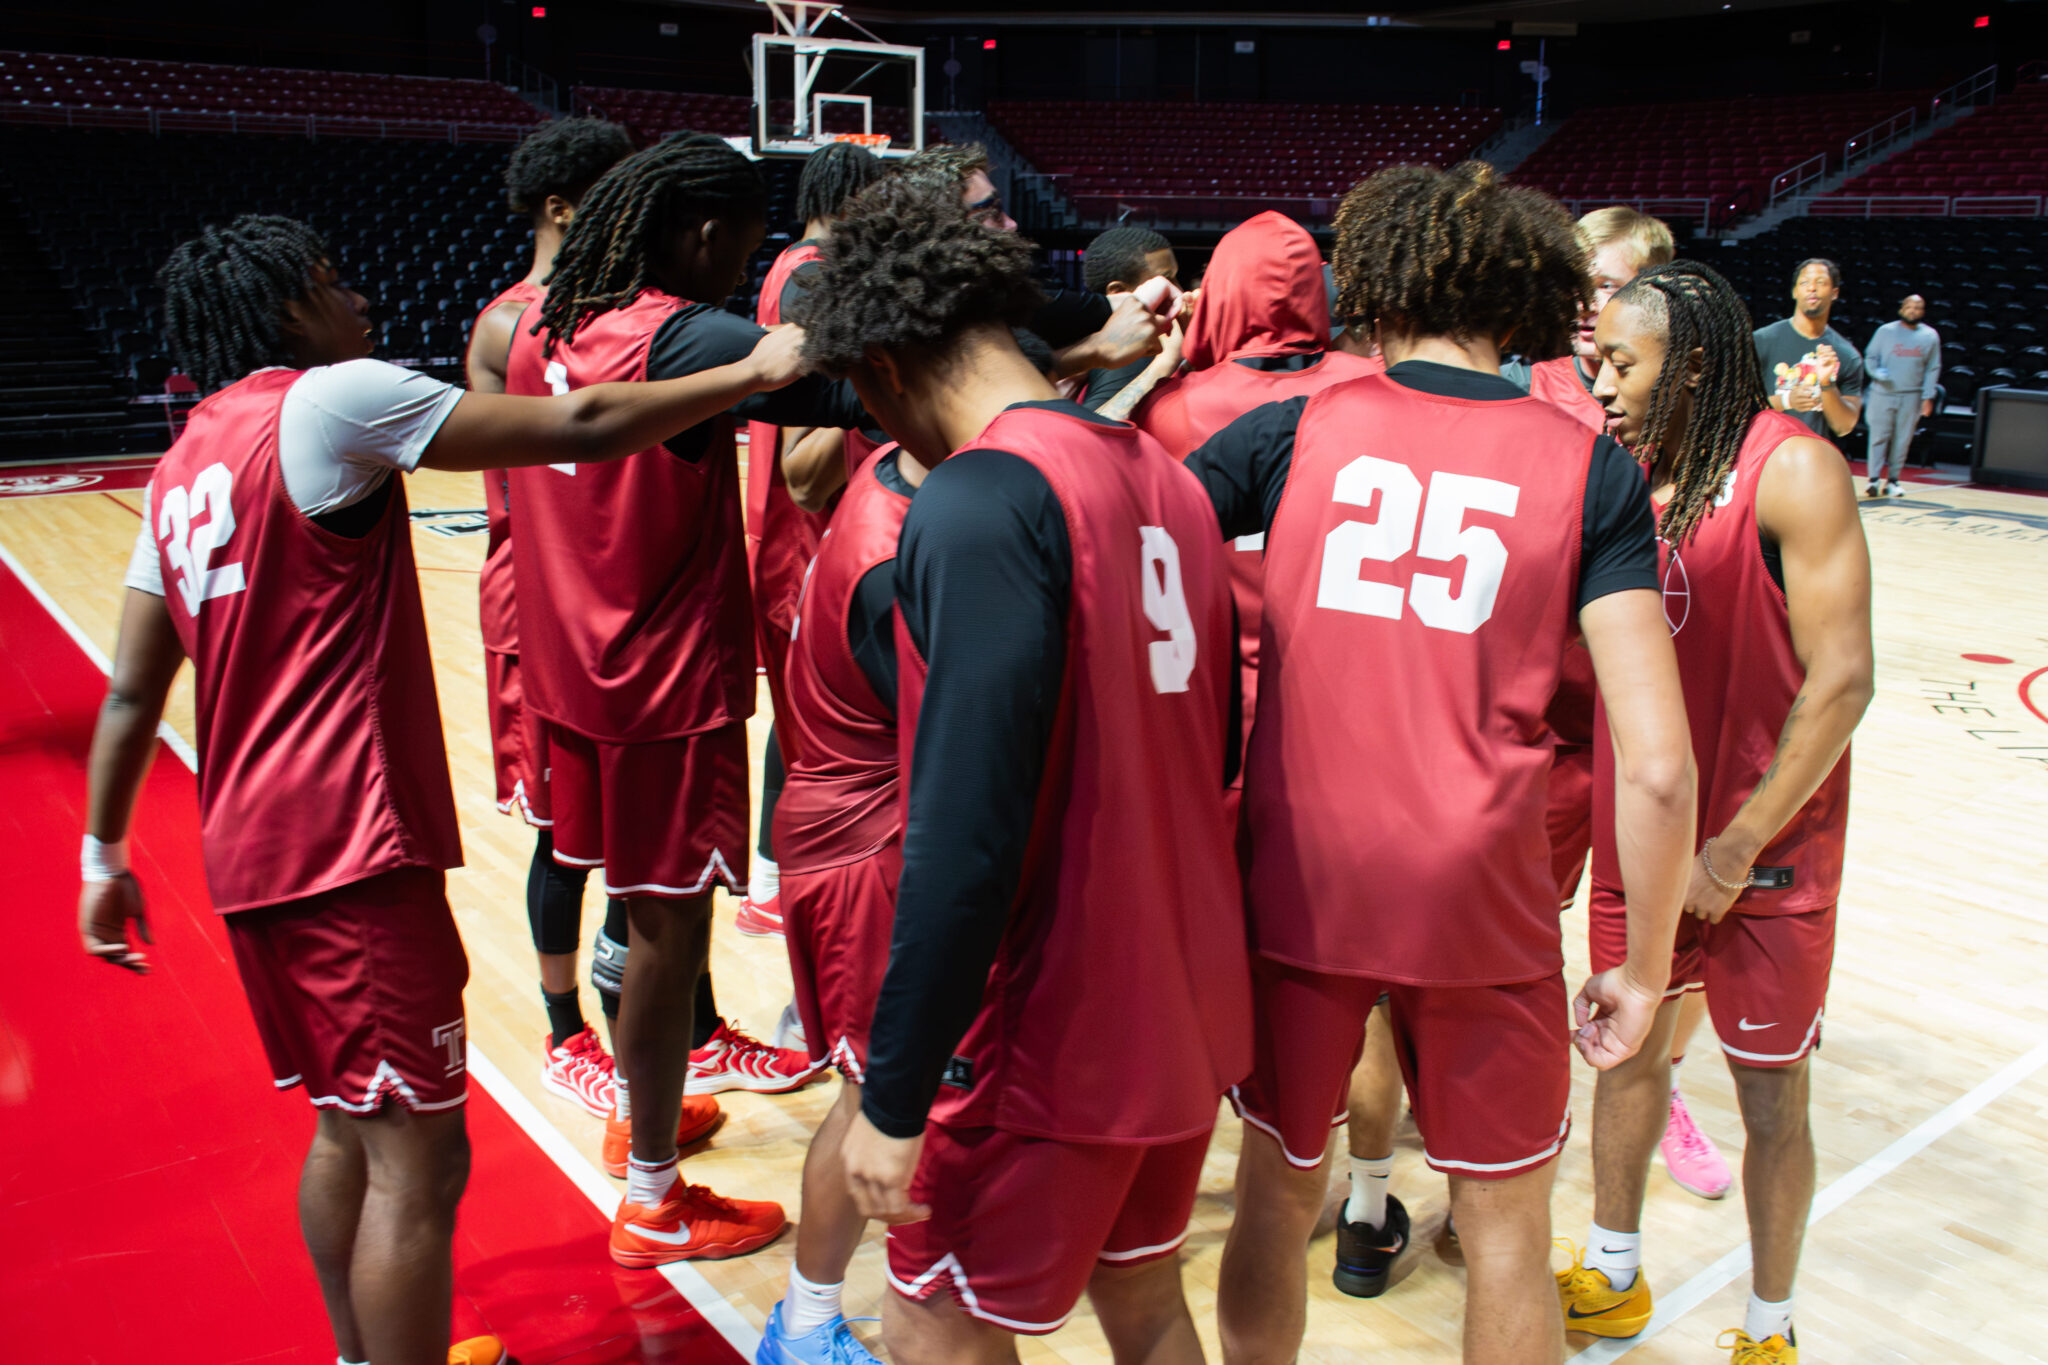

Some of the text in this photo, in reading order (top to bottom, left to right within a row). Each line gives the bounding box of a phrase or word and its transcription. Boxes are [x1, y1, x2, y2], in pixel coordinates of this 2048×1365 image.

[159, 462, 247, 618] 32
[1138, 525, 1198, 694] 9
[1316, 455, 1520, 634] 25
[1920, 678, 1997, 718] THE
